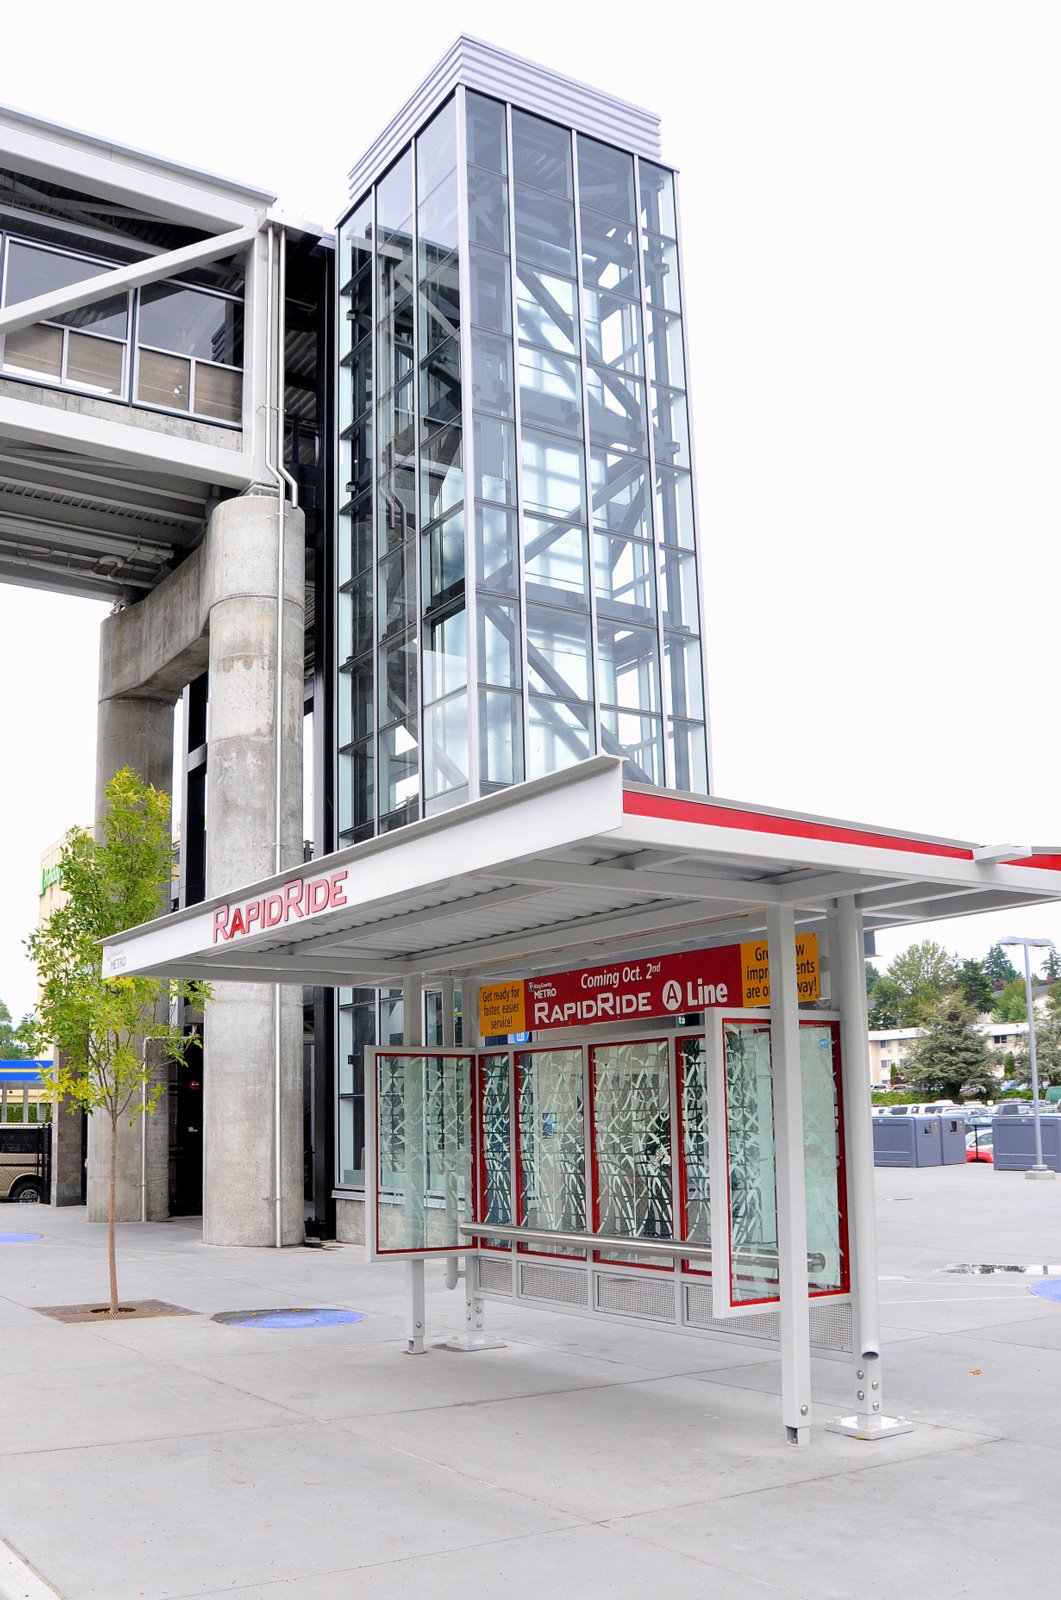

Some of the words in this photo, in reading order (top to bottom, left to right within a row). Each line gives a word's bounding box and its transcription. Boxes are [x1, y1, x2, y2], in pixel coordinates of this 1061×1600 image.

[213, 870, 348, 943] RAPIDRIDE
[580, 969, 620, 989] Coming
[622, 966, 643, 983] Oct.
[645, 962, 661, 980] 2nd
[482, 991, 493, 1003] Get
[494, 986, 510, 1002] ready
[511, 985, 520, 999] for
[533, 987, 557, 1000] METRO
[534, 991, 652, 1025] RAPIDRIDE
[687, 978, 728, 1007] Line
[746, 987, 761, 999] are
[483, 1003, 500, 1017] faster,
[502, 1001, 520, 1014] easier
[490, 1016, 513, 1030] service!
